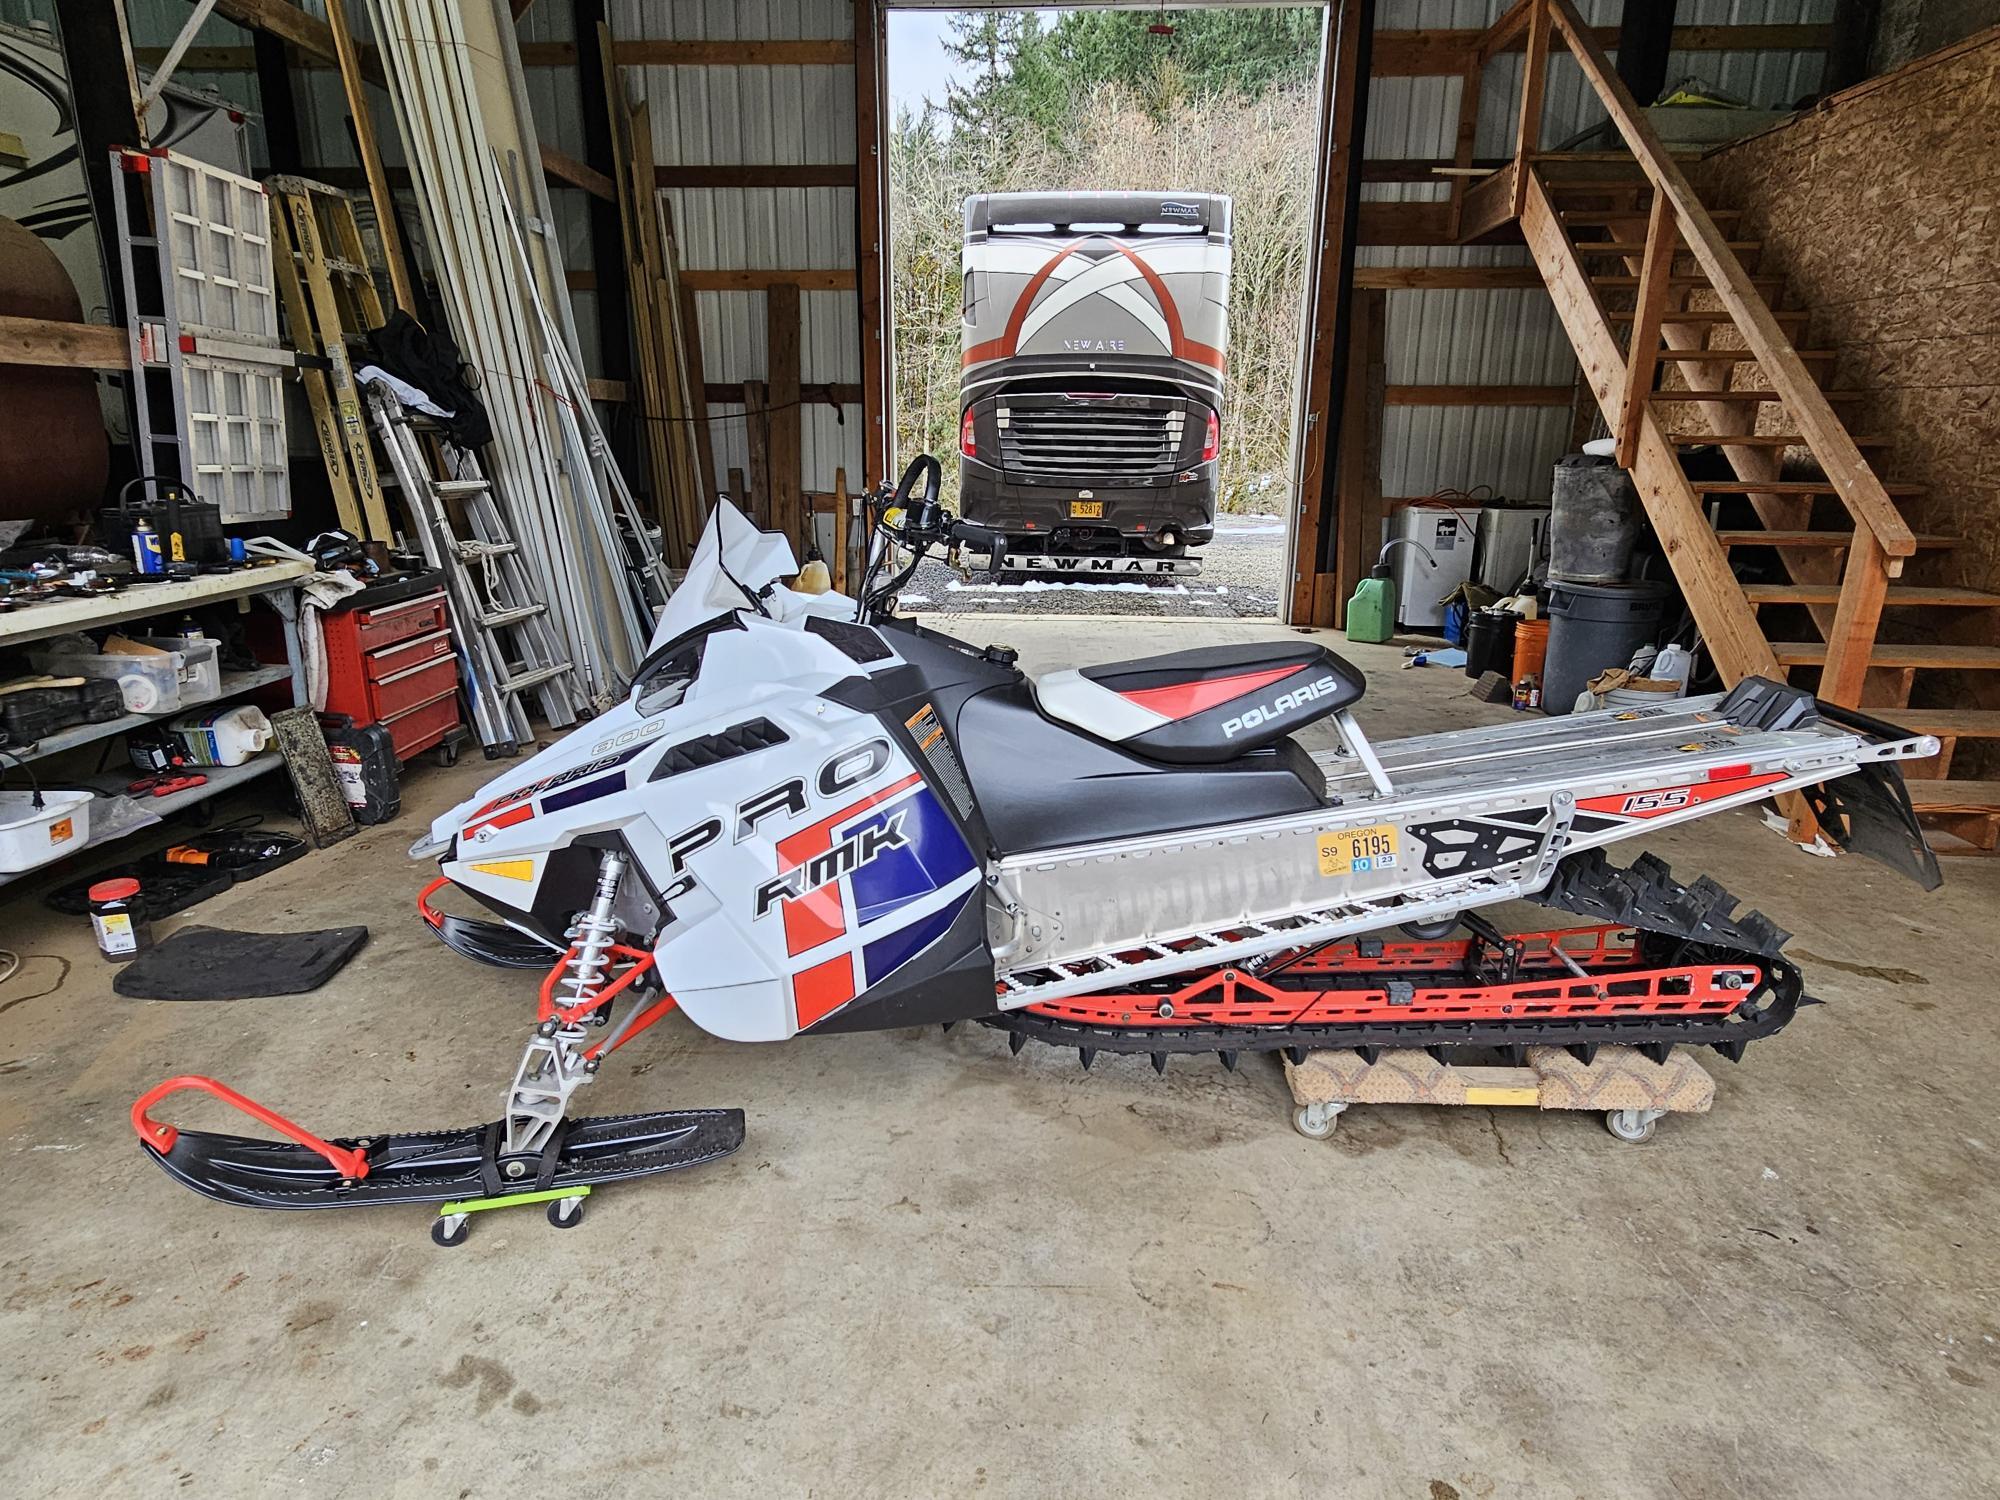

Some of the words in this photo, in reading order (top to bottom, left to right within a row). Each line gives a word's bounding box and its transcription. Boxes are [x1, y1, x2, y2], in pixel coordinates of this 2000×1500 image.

[1063, 339, 1092, 351] NEW
[1000, 556, 1176, 573] NEWMAR
[1221, 675, 1338, 739] POLARIS
[591, 718, 666, 757] 800
[491, 752, 623, 811] POLARIS
[666, 735, 894, 880] PRO
[1620, 788, 1691, 815] 155
[1321, 846, 1338, 858] S9
[1352, 834, 1390, 858] 6195
[1337, 828, 1377, 840] OREGON
[752, 807, 912, 922] RMK
[1353, 859, 1369, 871] 10
[1381, 855, 1393, 864] 23
